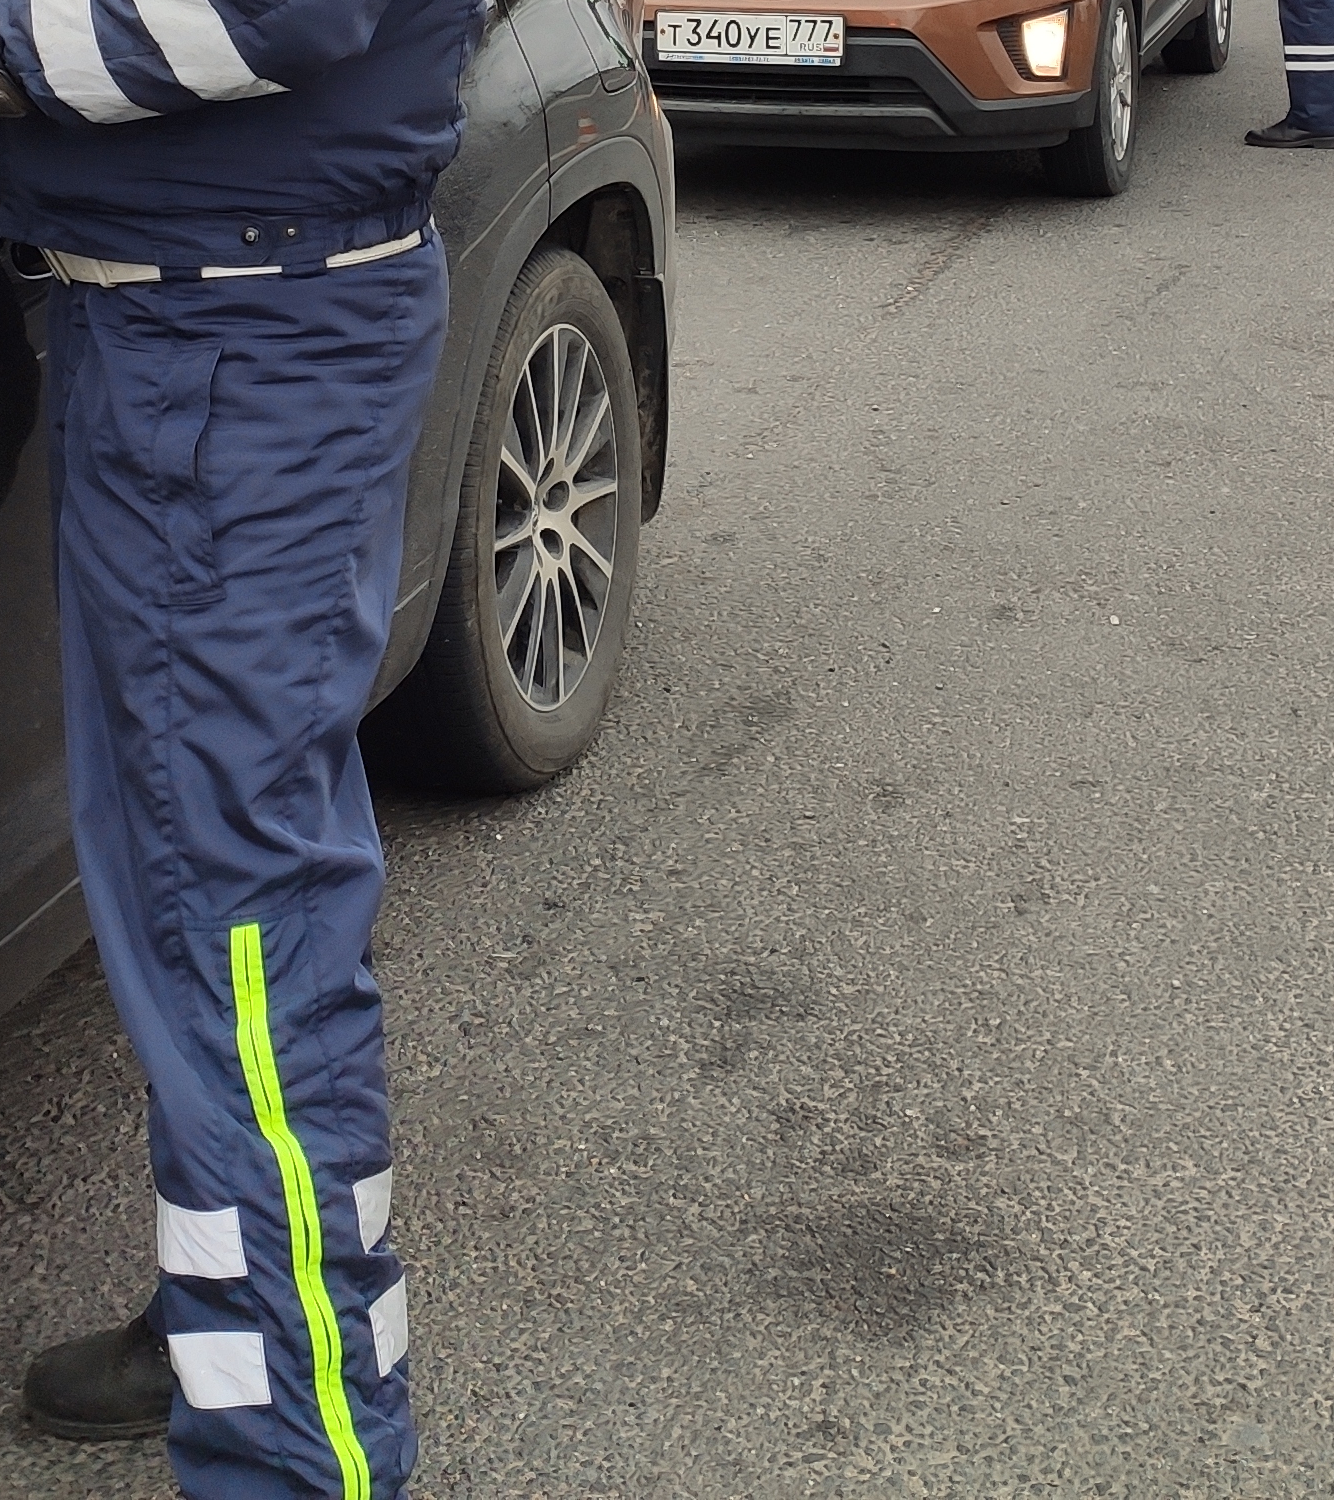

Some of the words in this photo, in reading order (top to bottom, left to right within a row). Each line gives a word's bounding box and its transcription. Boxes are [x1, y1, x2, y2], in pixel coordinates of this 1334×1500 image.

[667, 18, 782, 50] Т340УЕ
[788, 19, 834, 43] 777
[799, 42, 822, 52] RUS
